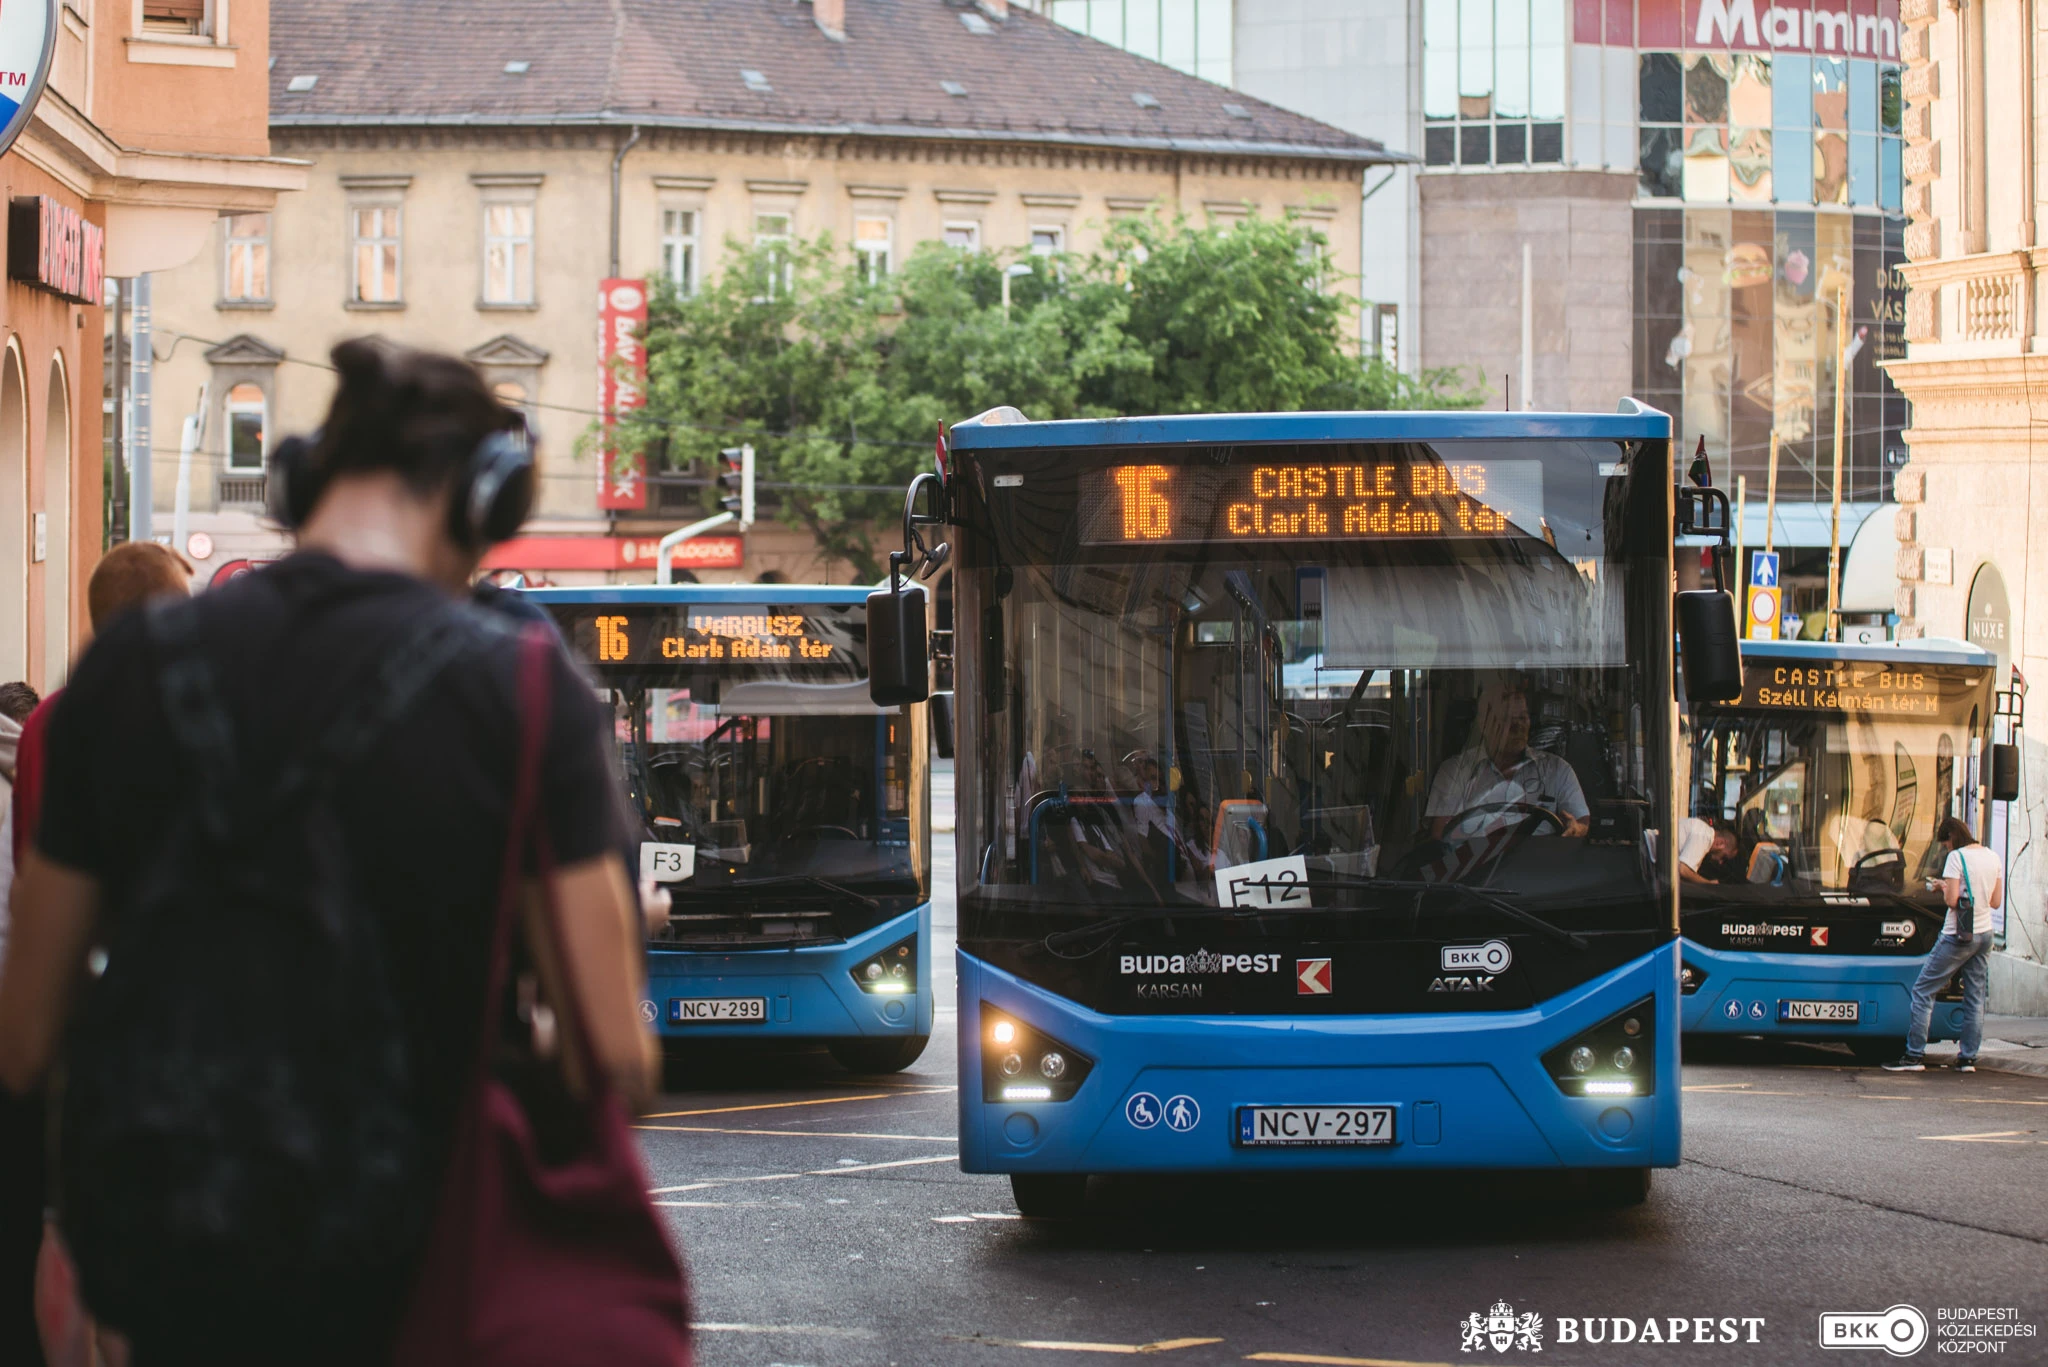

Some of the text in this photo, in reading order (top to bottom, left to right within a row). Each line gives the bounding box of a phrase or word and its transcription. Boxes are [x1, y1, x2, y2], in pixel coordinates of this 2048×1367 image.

[1695, 0, 1901, 57] Mamm
[1117, 465, 1486, 539] 16 CASTLE BUS
[1228, 503, 1328, 534] Clark
[1456, 501, 1512, 532] tér
[595, 615, 629, 661] 16
[1972, 621, 2005, 640] NUXE
[661, 637, 725, 658] Clark
[799, 637, 834, 658] tér
[1774, 667, 1925, 691] CASTLE BUS
[1758, 687, 1808, 707] Széll
[1813, 690, 1886, 710] Kálmán
[1890, 694, 1920, 712] tér
[1925, 695, 1938, 712] M
[653, 851, 682, 872] F3
[1451, 953, 1480, 964] BKK
[1137, 984, 1203, 999] KARSAN
[1427, 976, 1495, 992] ATAK
[683, 1002, 760, 1017] NCV-299
[1791, 1003, 1855, 1018] NCV-295
[1242, 1111, 1388, 1137] H NCV-297
